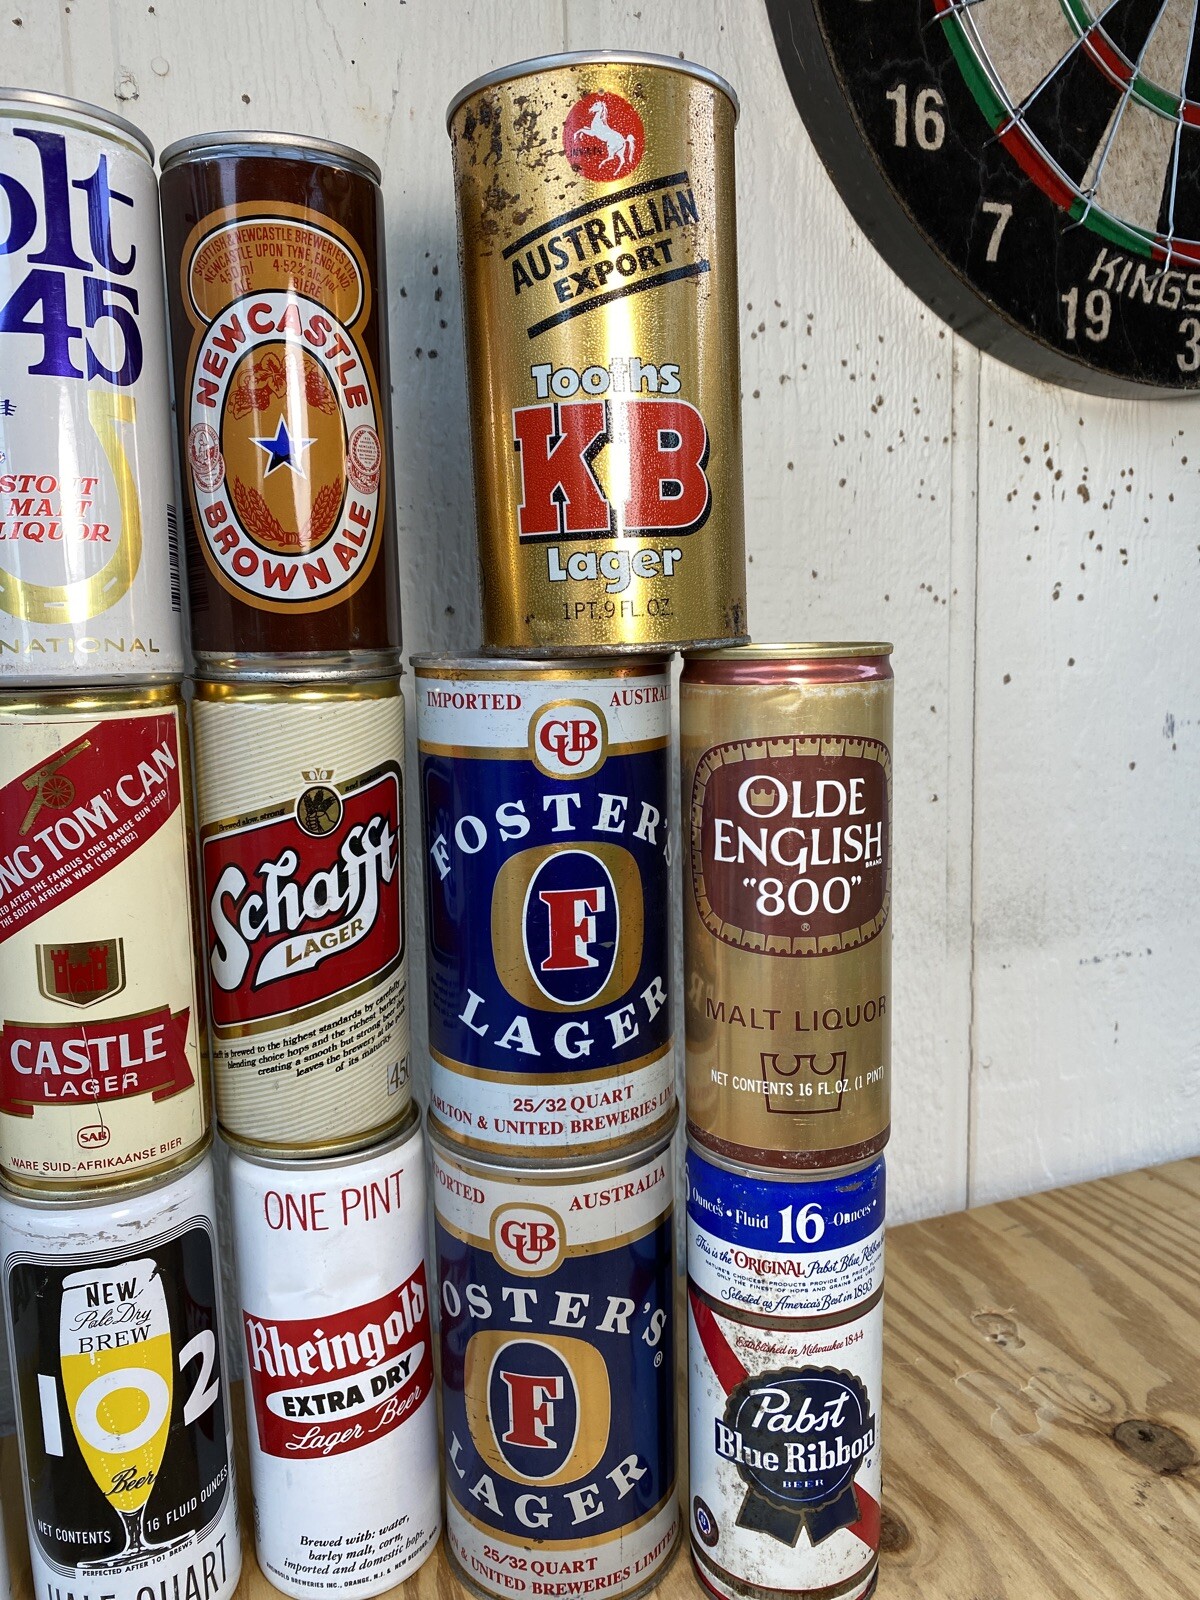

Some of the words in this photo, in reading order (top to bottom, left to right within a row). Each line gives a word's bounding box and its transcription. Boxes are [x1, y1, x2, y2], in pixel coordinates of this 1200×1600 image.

[886, 84, 945, 150] 16
[194, 235, 226, 276] SCOTTISH
[236, 226, 293, 243] NEWCASTLE
[295, 227, 346, 264] BREWERIES
[511, 189, 700, 296] AUSTRALIAN
[983, 201, 1013, 262] 7
[204, 245, 253, 284] NEWCASTLE
[255, 243, 283, 257] UPON
[314, 252, 351, 292] ENGLAND.
[220, 264, 240, 284] 450
[233, 278, 254, 296] ALE
[293, 277, 322, 299] BIERE
[553, 239, 674, 304] EXPORT
[0, 269, 143, 386] 45
[1062, 287, 1112, 342] 19
[195, 302, 369, 409] NEWCASTLE
[530, 357, 682, 399] Tooths
[0, 474, 99, 496] STOT
[512, 399, 712, 545] KB
[7, 497, 93, 519] MAT
[203, 500, 332, 592] BROWN
[332, 501, 373, 572] ALE
[547, 547, 682, 594] Lager
[427, 691, 522, 710] IMPORTED
[116, 741, 176, 807] CAN
[738, 775, 867, 819] OLDE
[260, 807, 286, 821] strong
[9, 891, 32, 910] AFTER
[31, 880, 48, 894] THE
[47, 857, 83, 883] FAMOUS
[83, 842, 107, 860] LONG
[107, 821, 135, 844] RANGE
[134, 807, 151, 822] GUN
[151, 789, 167, 808] USED
[714, 818, 883, 875] ENGLISH
[865, 857, 883, 869] BRAND
[13, 900, 38, 920] SOUTH
[37, 876, 73, 903] AFRICAN
[72, 863, 95, 880] WAR
[96, 830, 139, 867] (1899-1902)
[210, 815, 400, 990] Schafft
[285, 918, 365, 968] LAGER
[538, 886, 606, 972] F
[230, 1045, 255, 1058] brewed
[282, 1028, 317, 1048] highest
[319, 1009, 362, 1034] standards
[458, 975, 668, 1060] LAGER
[706, 997, 781, 1031] MALT
[795, 995, 887, 1031] LIQUOR
[10, 1024, 168, 1076] CASTLE
[227, 1058, 257, 1070] blending
[258, 1052, 285, 1064] choice
[287, 1044, 310, 1058] hops
[311, 1034, 329, 1049] and
[331, 1029, 346, 1040] the
[348, 1012, 377, 1033] richest
[257, 1060, 293, 1076] creating
[303, 1043, 338, 1063] smooth
[356, 1019, 381, 1040] strong
[296, 1060, 324, 1077] leaves
[326, 1053, 341, 1065] the
[342, 1034, 376, 1058] brewery
[43, 1072, 139, 1098] LAGER
[513, 1098, 567, 1113] 25/32
[570, 1084, 634, 1113] QUART
[711, 1069, 729, 1086] NET
[732, 1075, 794, 1096] CONTENTS
[799, 1082, 813, 1096] 16
[80, 1130, 108, 1142] SAB
[431, 1089, 472, 1126] ARLTON
[494, 1117, 564, 1136] UNITED
[570, 1097, 657, 1135] BREWERIES
[11, 1157, 39, 1171] WARE
[42, 1150, 157, 1172] SUID-AFRIKAANSE
[160, 1137, 183, 1153] BIER
[264, 1190, 329, 1231] ONE
[341, 1169, 404, 1226] PINT
[569, 1165, 666, 1211] AUSTRALIA
[692, 1187, 724, 1217] Ounces
[736, 1209, 769, 1229] Fluid
[778, 1203, 825, 1244] 16
[833, 1205, 871, 1227] Ounces
[695, 1233, 711, 1254] This
[734, 1250, 806, 1278] ORIGINAL
[804, 1259, 839, 1279] Pabst
[835, 1252, 860, 1274] Blue
[86, 1278, 137, 1308] NEW
[720, 1286, 762, 1306] Selected
[816, 1292, 844, 1312] Best
[853, 1277, 874, 1300] 1893
[732, 1272, 766, 1284] CHOICEST
[768, 1280, 807, 1288] PRODUCTS
[809, 1277, 838, 1287] PROVIDE
[749, 1283, 774, 1292] FINEST
[829, 1280, 851, 1290] GRAINS
[69, 1308, 114, 1332] Pale
[112, 1302, 152, 1326] Dry
[79, 1324, 152, 1354] BREW
[246, 1280, 425, 1378] Rheingold
[736, 1335, 786, 1355] Established
[796, 1341, 845, 1358] Milwaukee
[845, 1329, 864, 1346] 1844
[38, 1329, 220, 1457] 102
[282, 1385, 365, 1418] EXTRA
[370, 1352, 412, 1397] DRY
[285, 1423, 365, 1455] Lager
[368, 1385, 421, 1433] Beer
[500, 1370, 564, 1449] F
[749, 1387, 850, 1434] Pabst
[716, 1422, 779, 1472] Blue
[784, 1429, 875, 1474] Ribbon
[102, 1465, 157, 1496] Beer
[449, 1431, 648, 1528] LAGER
[782, 1479, 824, 1488] BEER
[37, 1519, 53, 1537] NET
[55, 1528, 112, 1545] CONTENTS
[146, 1518, 160, 1533] 16
[166, 1497, 198, 1526] FLUID
[200, 1464, 229, 1503] OUNCES
[284, 1557, 331, 1575] imported
[332, 1561, 357, 1575] and
[358, 1544, 404, 1571] domestic
[405, 1529, 425, 1549] hops.
[300, 1535, 343, 1548] Brewed
[345, 1530, 376, 1546] with:
[378, 1514, 410, 1536] water,
[308, 1549, 343, 1565] barley
[346, 1543, 376, 1560] malt,
[378, 1532, 404, 1550] corn,
[82, 1567, 122, 1577] PERFECTED
[124, 1562, 149, 1573] AFTER
[169, 1539, 193, 1557] BREWS
[471, 1555, 526, 1592] UNITED
[531, 1565, 631, 1596] BREWERIES
[634, 1520, 677, 1574] LIMITED
[483, 1545, 528, 1571] 25/32
[530, 1557, 599, 1577] QUART
[290, 1576, 324, 1589] BREWERIES
[343, 1576, 373, 1588] ORANGE,
